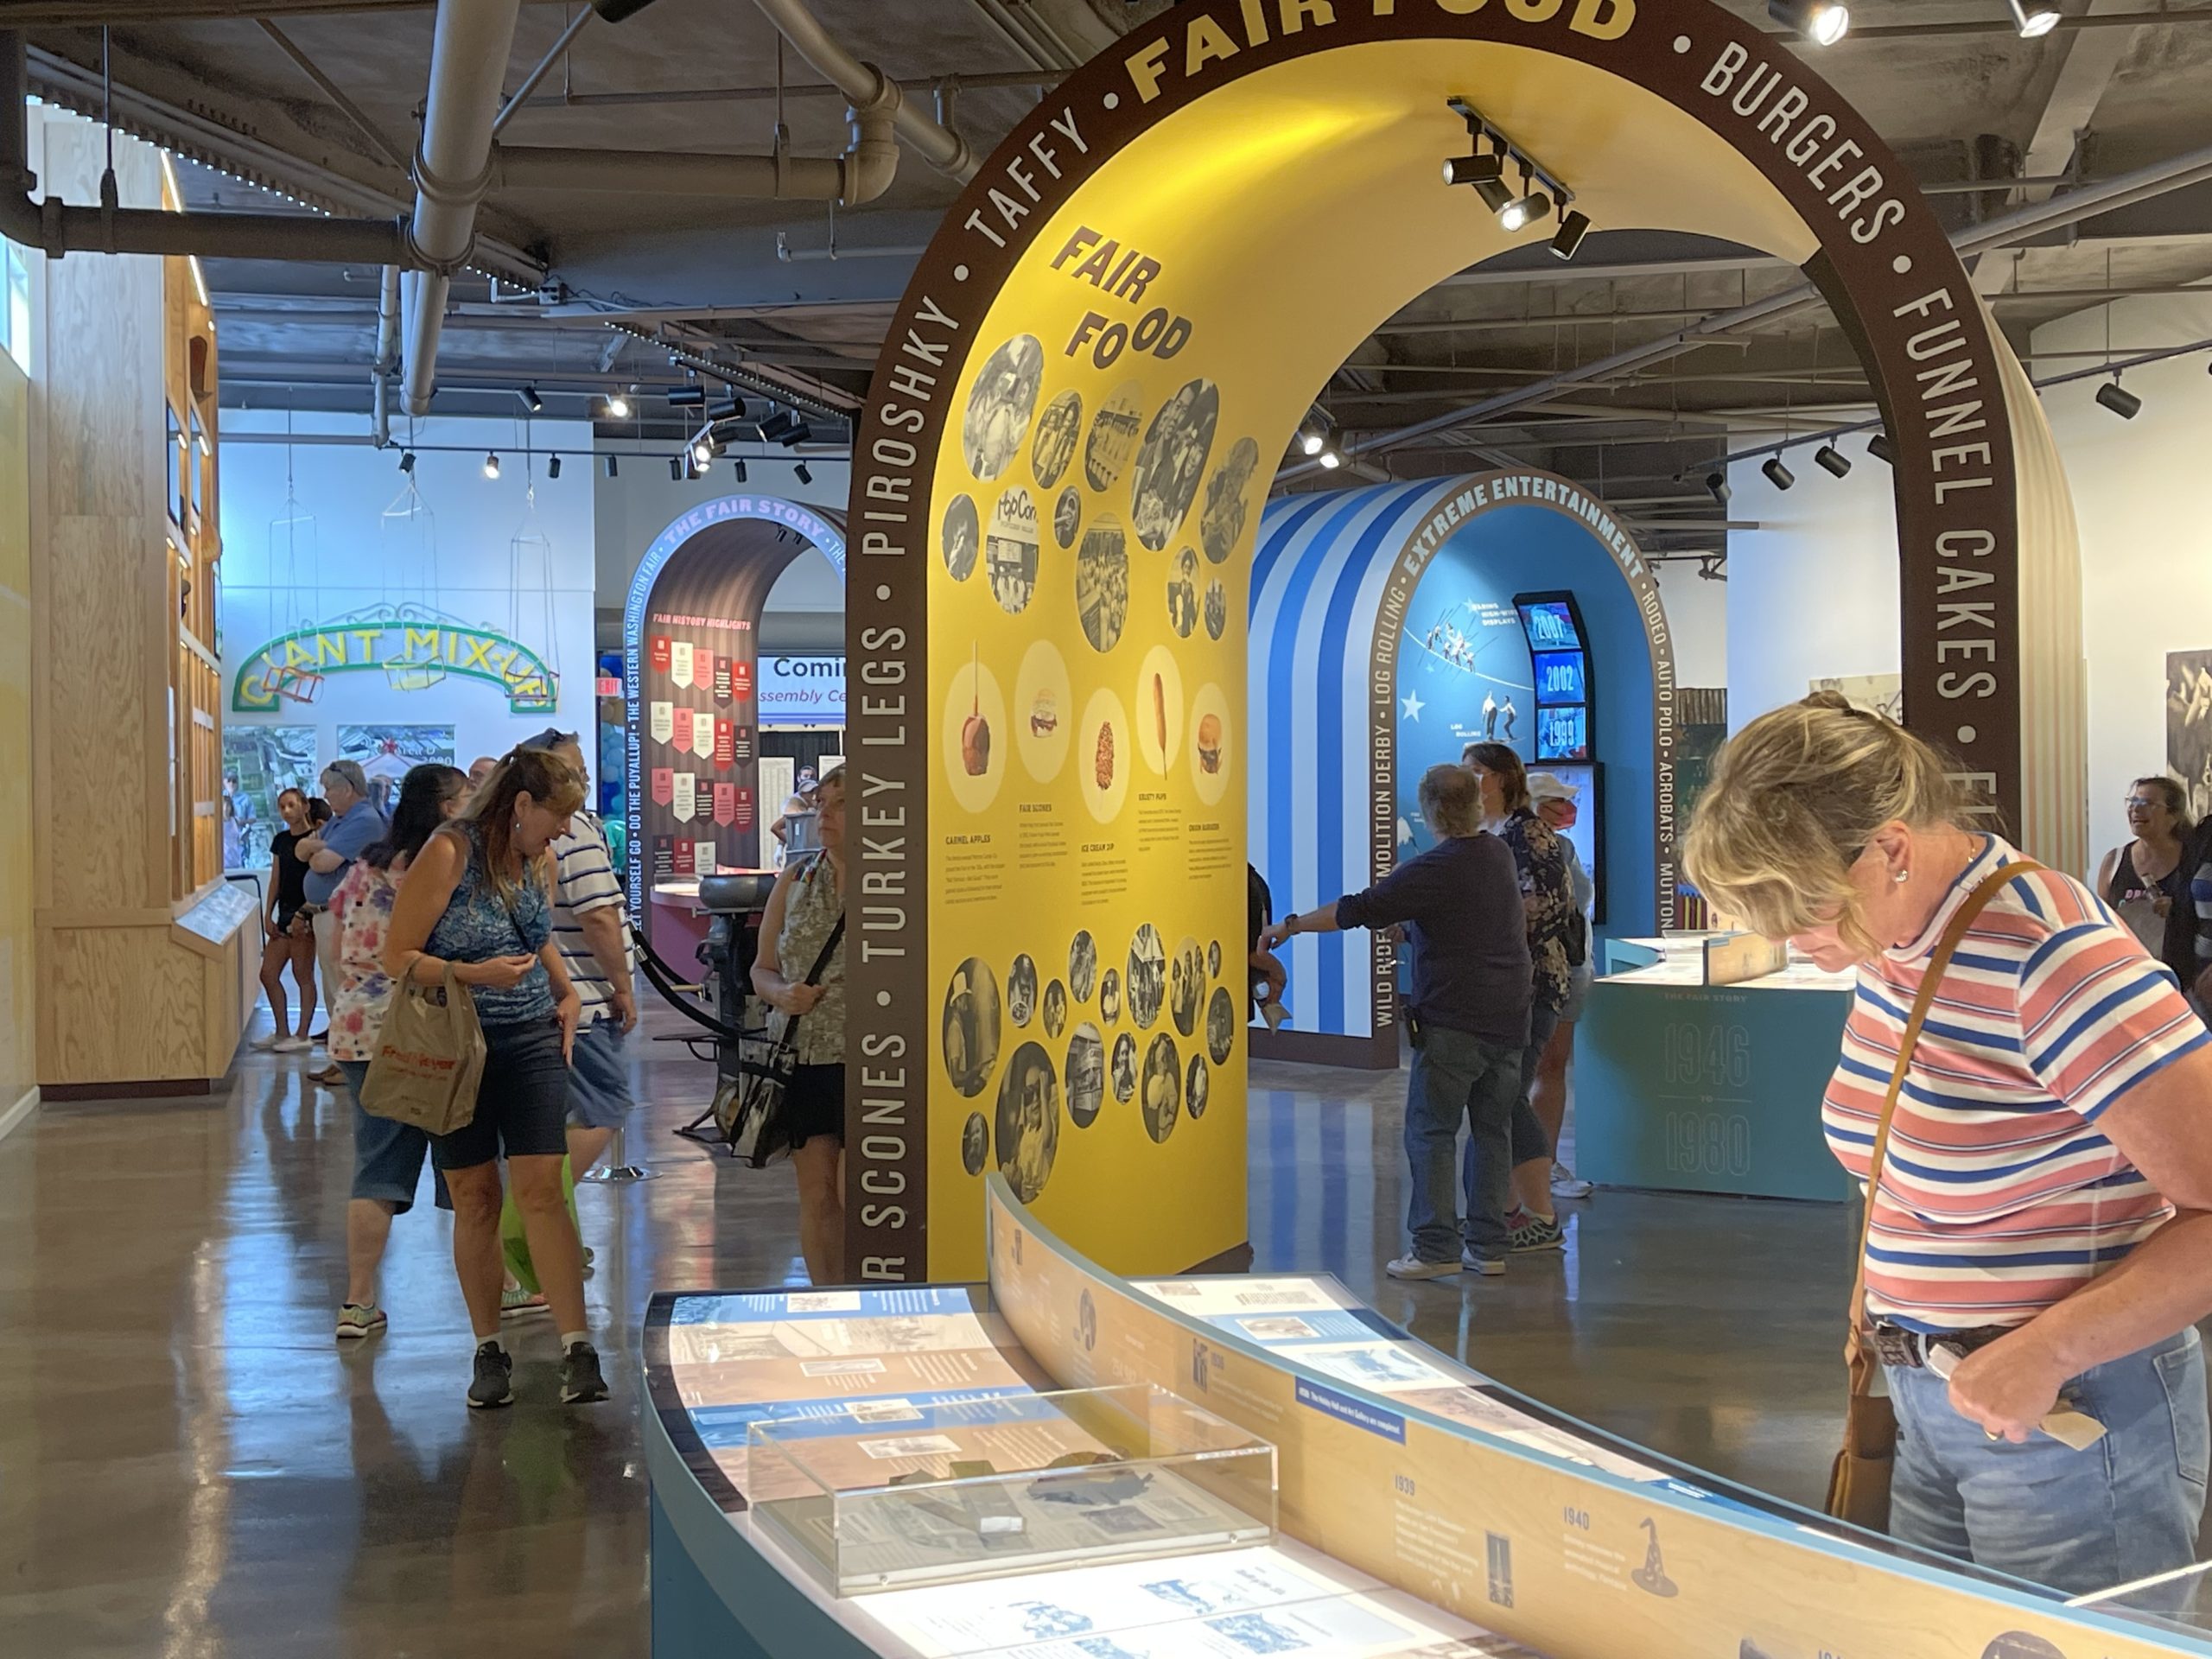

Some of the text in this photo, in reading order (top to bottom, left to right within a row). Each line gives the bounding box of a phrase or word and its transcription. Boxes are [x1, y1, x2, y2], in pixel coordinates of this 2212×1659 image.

[1125, 0, 1336, 104] FAIR
[963, 106, 1089, 248] TAFFY
[1700, 41, 1905, 245] BURGERS
[1049, 225, 1161, 304] FAIR
[1065, 307, 1192, 370] FOOD
[862, 296, 960, 556] PIROSHKY
[1892, 288, 1994, 505] FUNNEL
[664, 499, 825, 545] THE FAIR STORY
[1403, 475, 1644, 579] EXTREME ENTERTAINMENT
[626, 551, 662, 722] THE WESTERN WASHINGTON FAIR
[653, 613, 751, 631] FAIR HISTORY HIGHLIGHTS
[1375, 586, 1407, 705] LOG ROLLING
[1642, 589, 1668, 645] RODEO
[1936, 530, 1998, 699] CAKES
[1546, 664, 1574, 693] 2002
[1656, 660, 1673, 747] AUTO POLO
[1550, 720, 1575, 747] 1999
[628, 730, 642, 829] DO THE PUYALLUP!
[861, 626, 907, 963] TURKEY LEGS
[1375, 724, 1393, 885] MOLITION DERBY
[1659, 761, 1674, 842] ACROBATS
[629, 840, 642, 855] GO
[969, 834, 991, 843] APPLES
[629, 857, 642, 912] YOURSELF
[1660, 863, 1675, 929] MUTTON
[1376, 982, 1393, 1027] WILD
[1664, 993, 1748, 1003] THE FAIR STORY
[1665, 1022, 1750, 1088] 1946
[861, 1032, 907, 1230] SCONES
[1666, 1111, 1751, 1177] 1980
[1394, 1474, 1415, 1496] 1939
[1563, 1506, 1590, 1530] 1940
